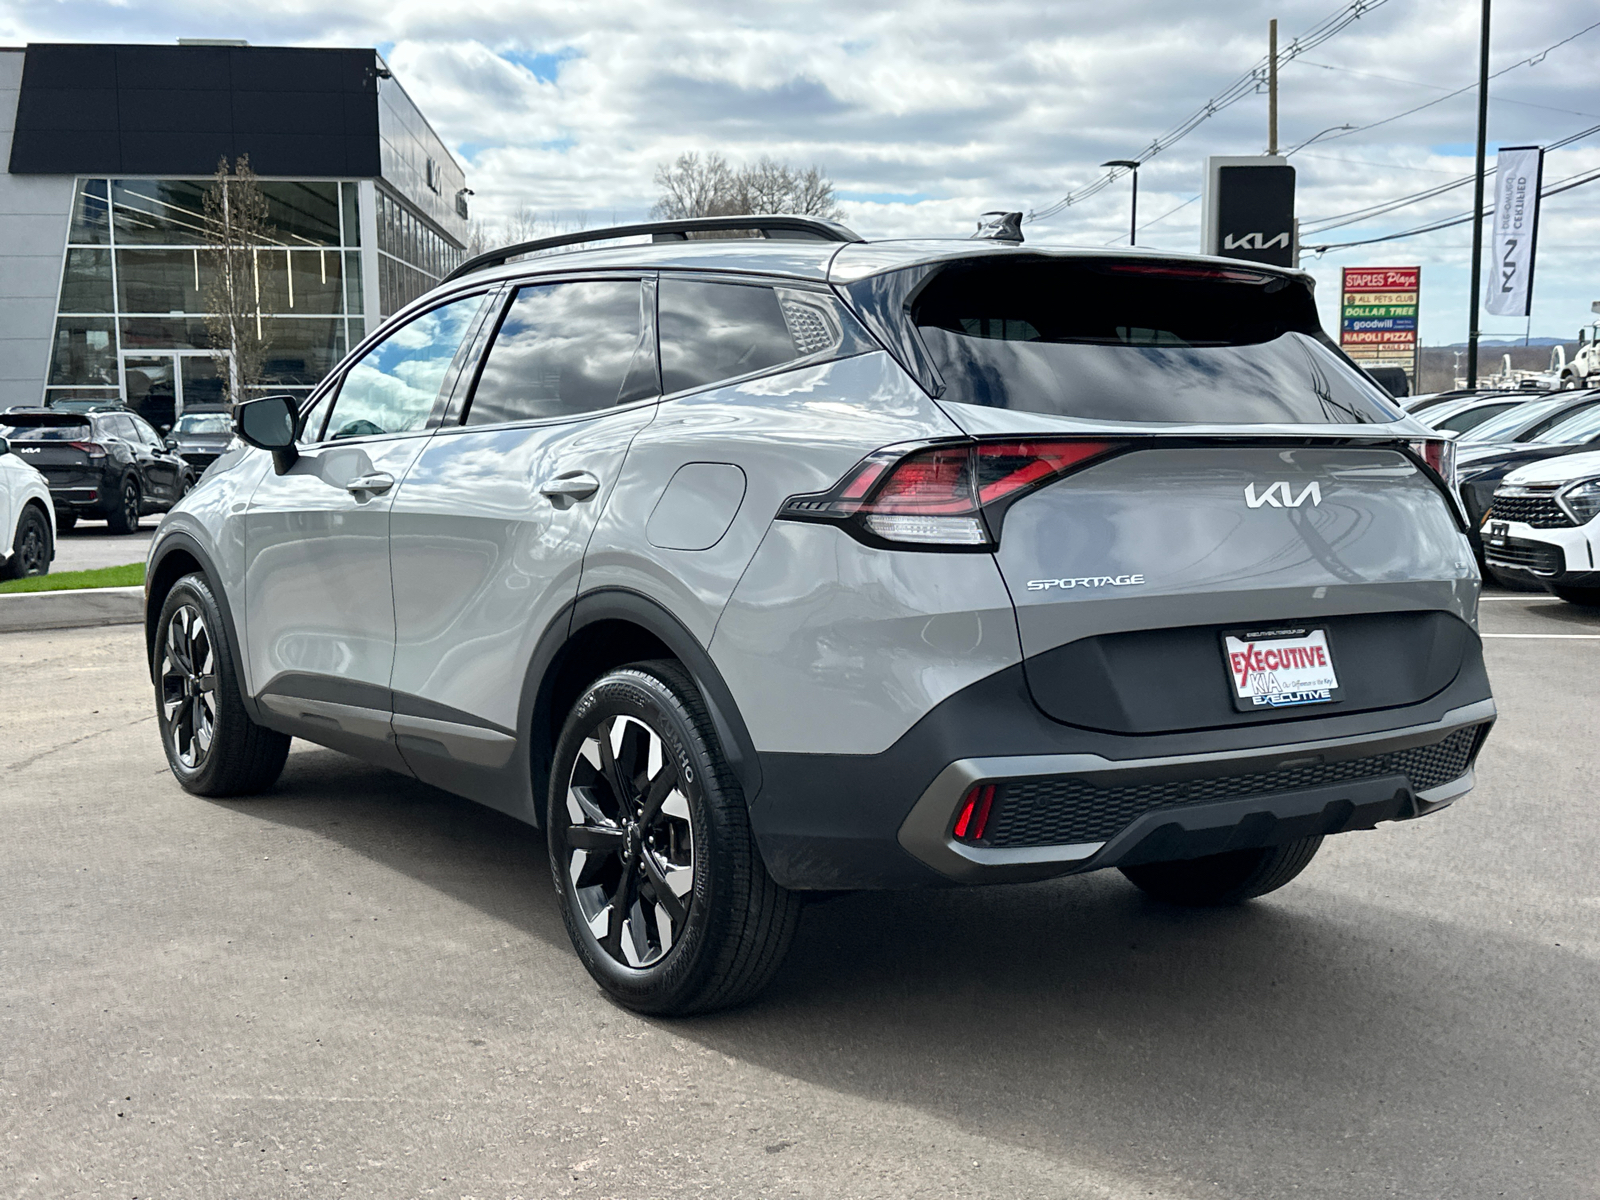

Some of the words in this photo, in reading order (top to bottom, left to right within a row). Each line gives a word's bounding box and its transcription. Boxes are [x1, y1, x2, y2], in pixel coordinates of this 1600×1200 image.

[1224, 232, 1289, 249] KIA
[1345, 274, 1384, 286] STAPLES
[1386, 272, 1416, 287] Plaza
[1358, 295, 1371, 303] ALL
[1374, 295, 1393, 303] PETS
[1395, 295, 1414, 303] CLUB
[1345, 307, 1386, 316] DOLLAR
[1389, 307, 1415, 316] TREE
[1353, 319, 1393, 330] goodwill
[1343, 332, 1382, 342] NAPOLI
[1383, 331, 1413, 342] PIZZA
[1244, 481, 1322, 508] KIA
[1027, 574, 1145, 591] SPORTAGE
[1229, 643, 1328, 688] EXECUTIVE
[1250, 671, 1283, 694] KIA
[1252, 690, 1331, 705] EXECUTIVE
